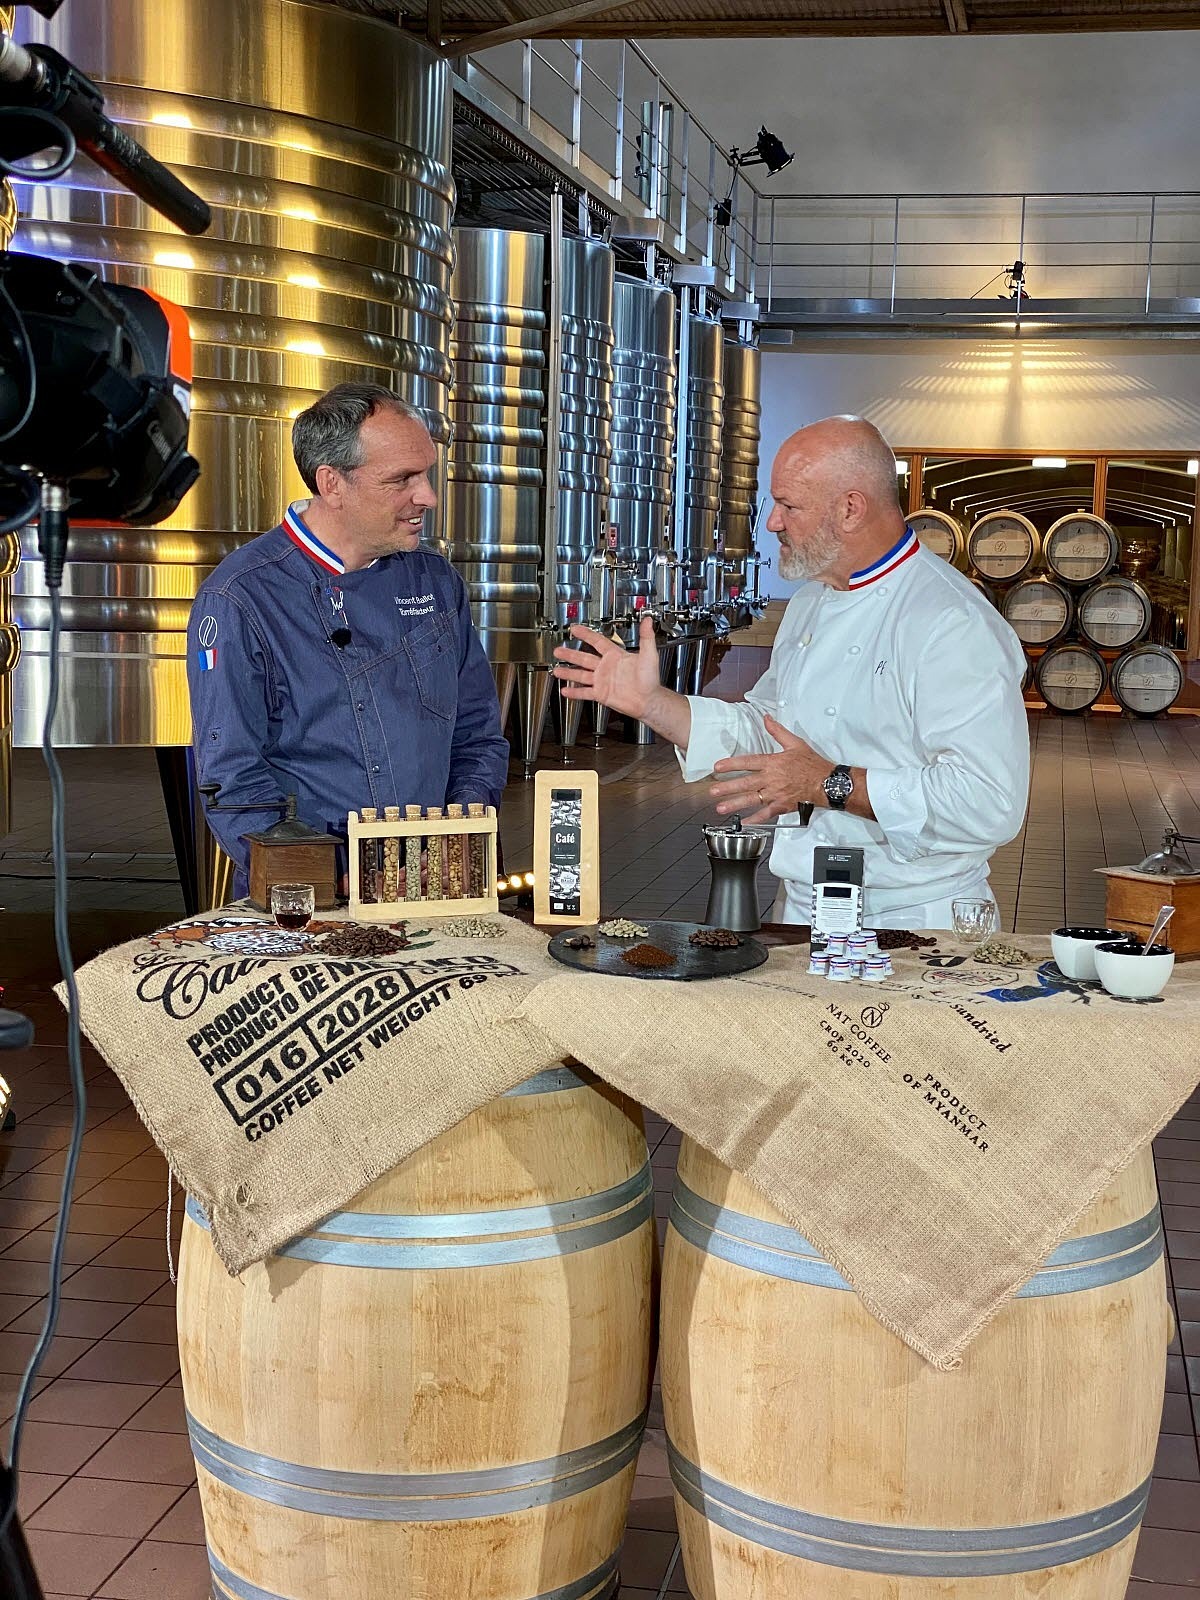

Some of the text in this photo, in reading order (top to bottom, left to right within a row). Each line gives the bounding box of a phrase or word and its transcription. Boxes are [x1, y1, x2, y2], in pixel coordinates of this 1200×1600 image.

[555, 832, 575, 844] Café
[186, 963, 320, 1057] PRODUCT OF
[200, 992, 299, 1077] PRODUCTO
[298, 972, 329, 1003] DE
[235, 1040, 307, 1103] 016
[317, 975, 401, 1045] 2028
[819, 1020, 870, 1068] CROP 2020
[826, 1003, 892, 1063] NAT COFFEE
[245, 973, 488, 1142] COFFEE NET WEIGHT 69
[827, 1040, 853, 1067] 60 KG
[902, 1074, 989, 1153] OF MYANMAR
[923, 1072, 987, 1131] PRODUCT
